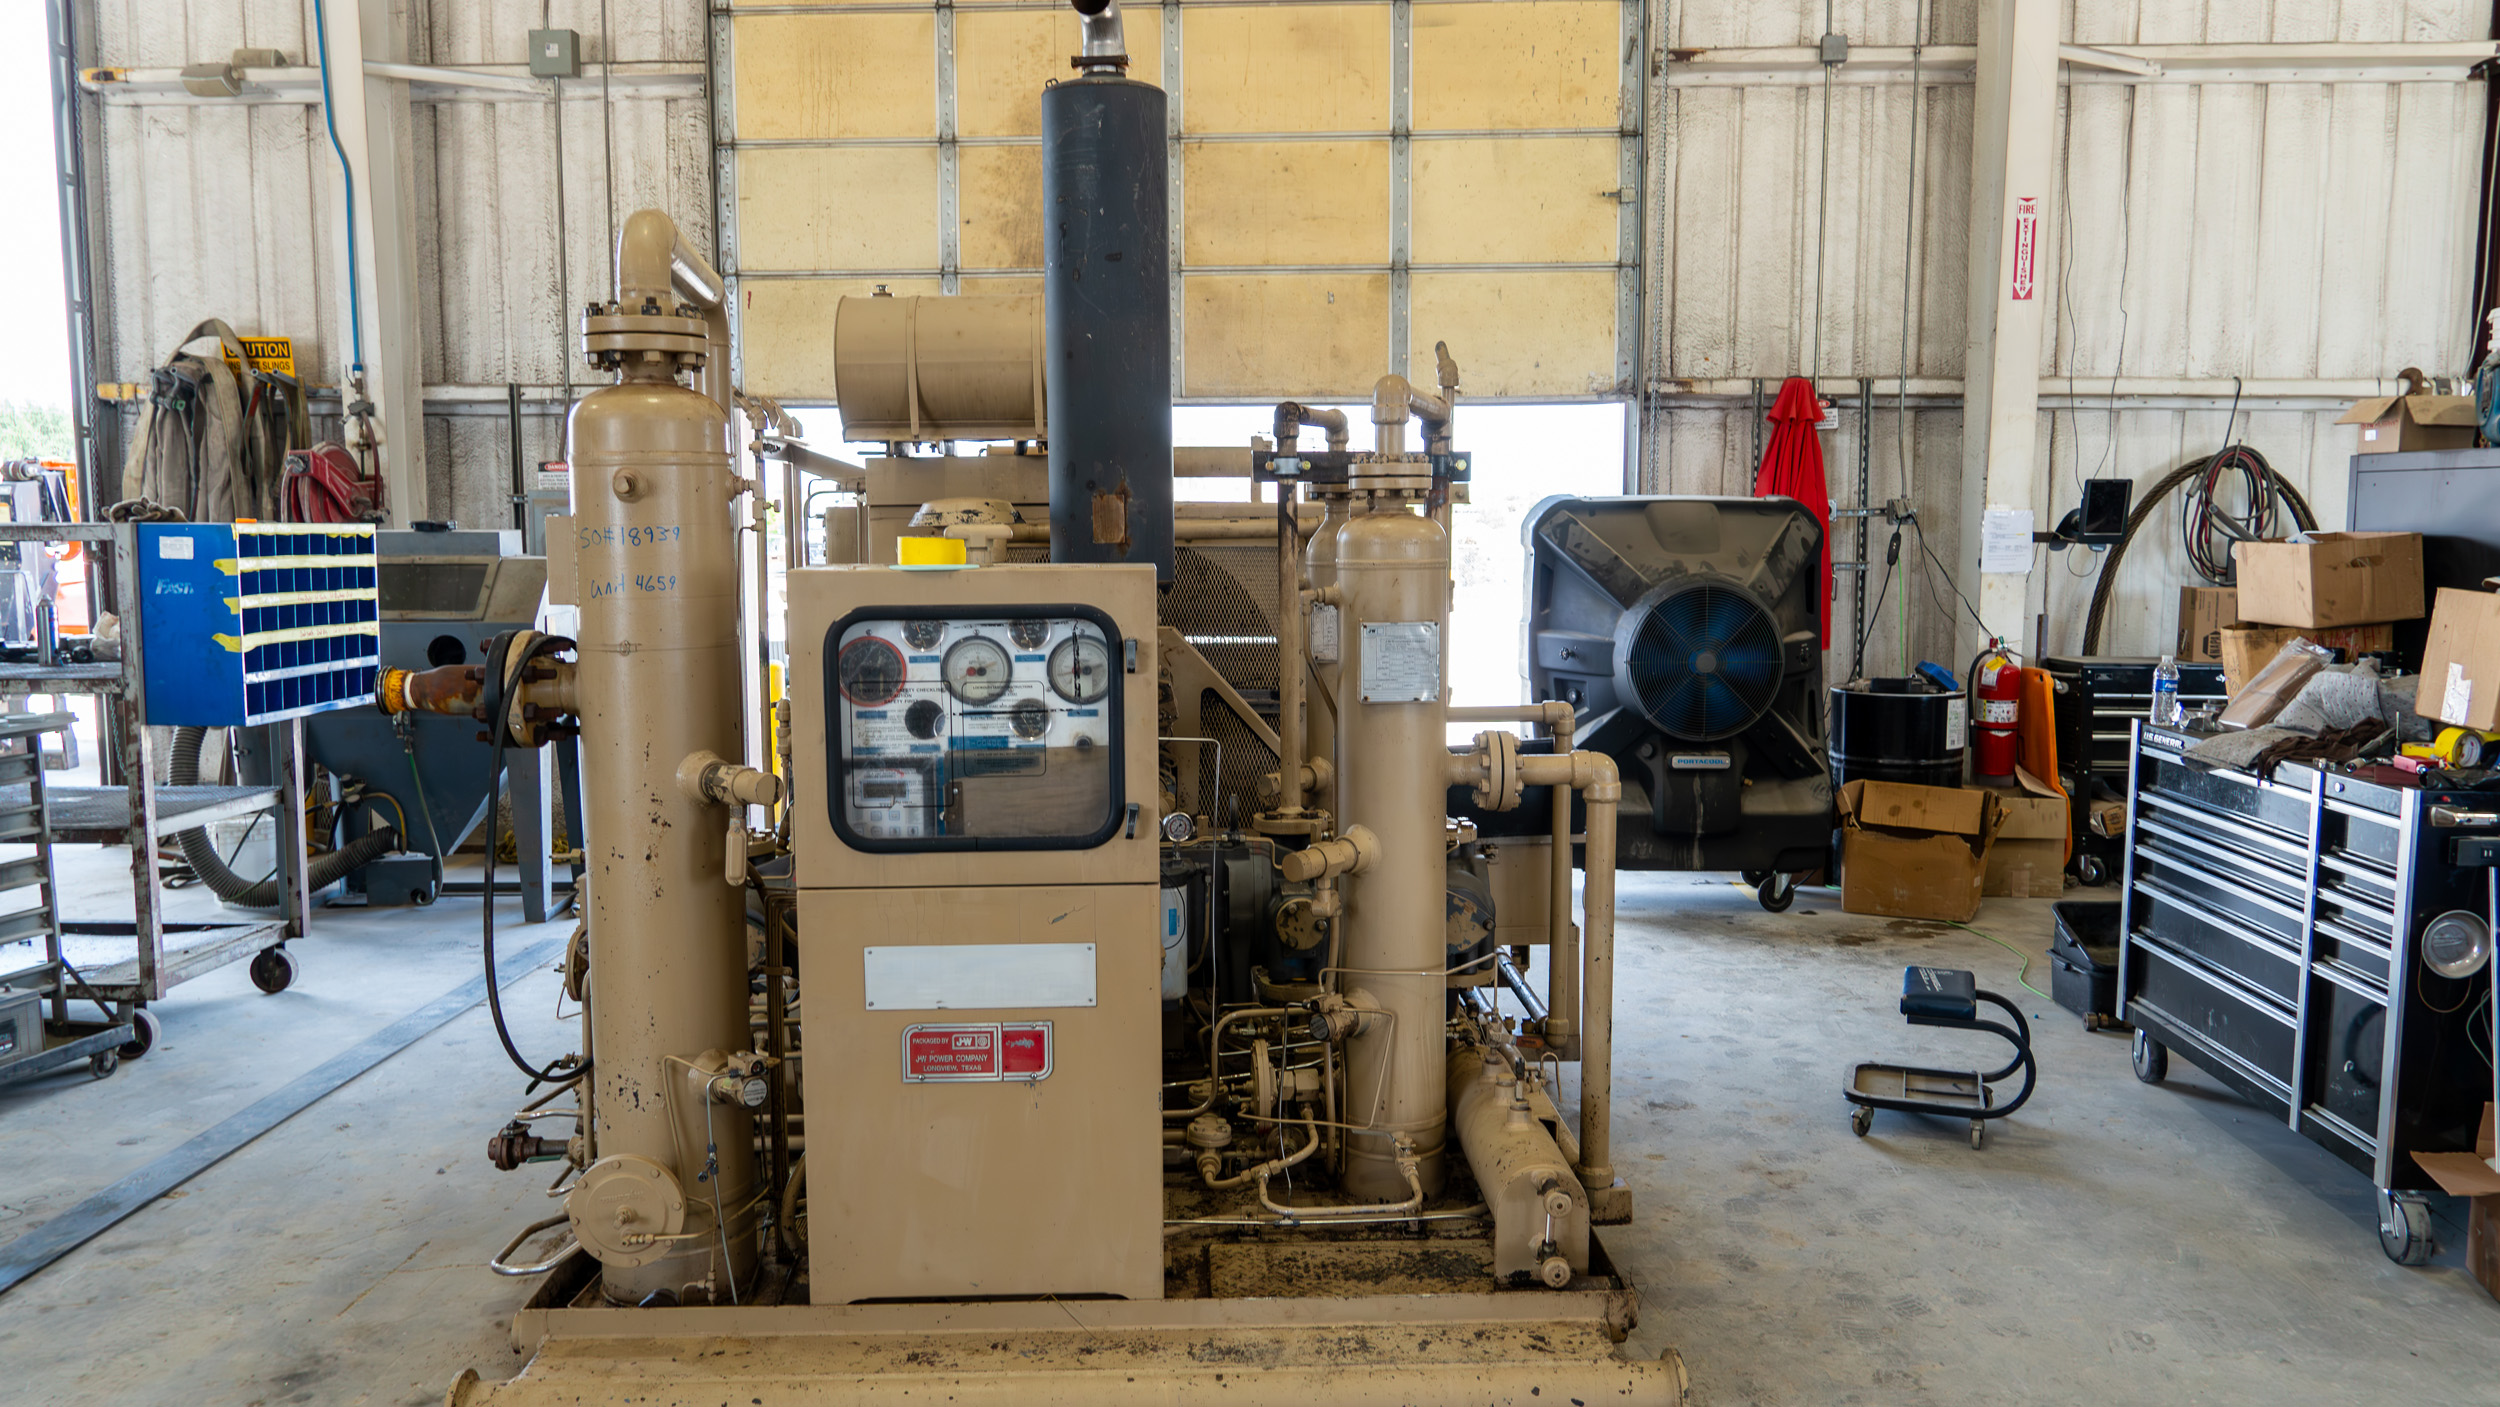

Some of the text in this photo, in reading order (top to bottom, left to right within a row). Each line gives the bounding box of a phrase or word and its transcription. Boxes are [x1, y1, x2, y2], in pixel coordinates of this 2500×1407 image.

[2018, 204, 2035, 214] FIRE
[2020, 218, 2029, 292] EXTINGUISHER
[226, 343, 289, 357] CUTION
[228, 361, 290, 371] INSCT SLINGS
[635, 575, 677, 592] 4659
[2153, 734, 2184, 750] GENERAL
[912, 1037, 940, 1045] PACKAGED
[929, 1054, 953, 1063] POWER
[955, 1054, 988, 1062] COMPANY
